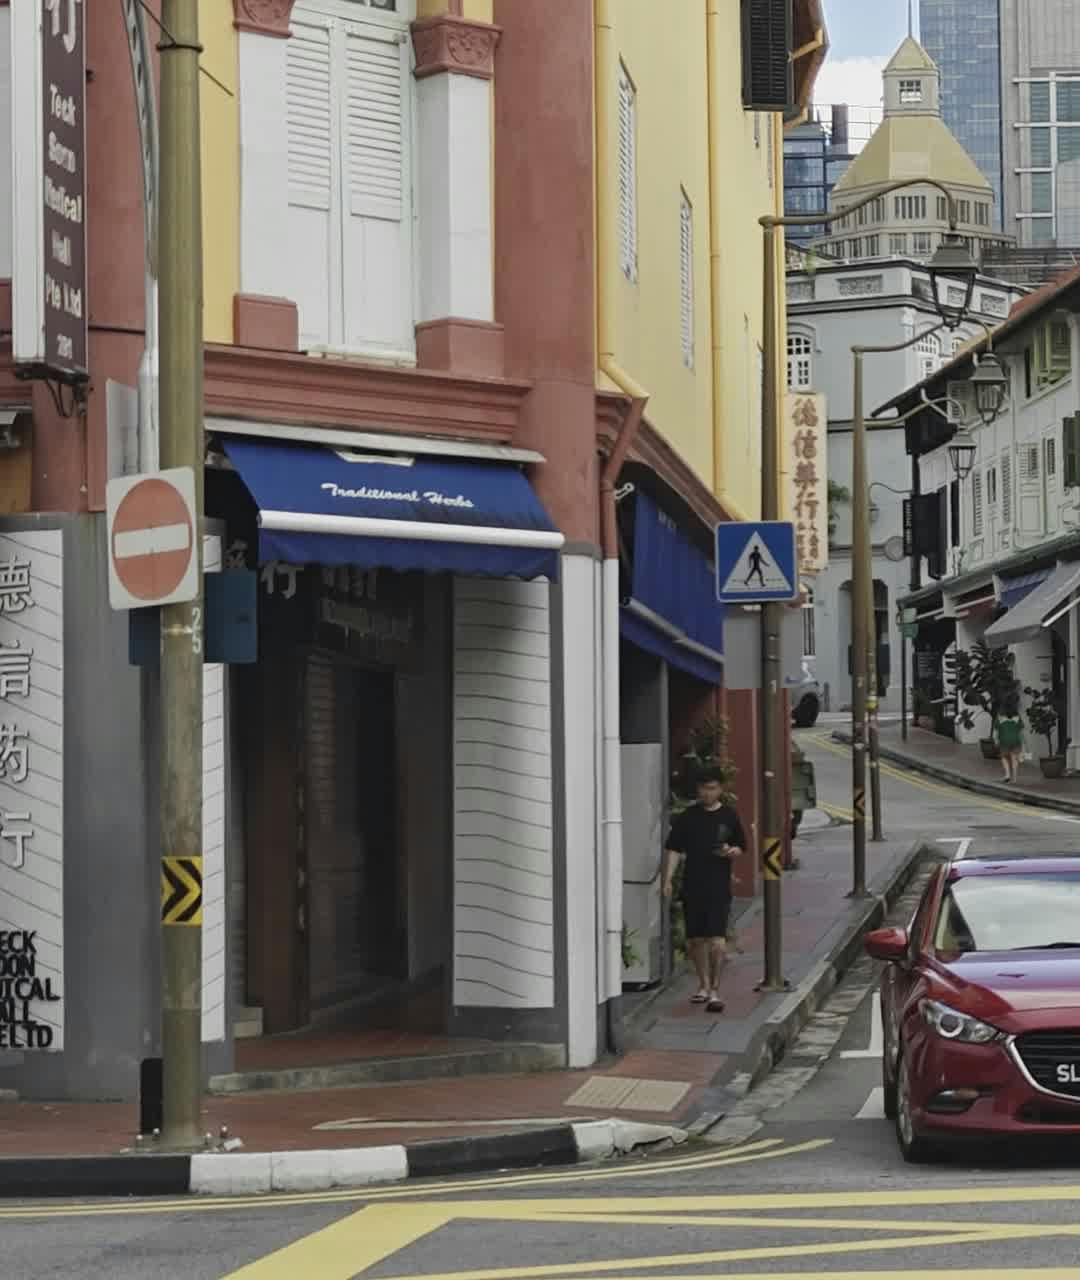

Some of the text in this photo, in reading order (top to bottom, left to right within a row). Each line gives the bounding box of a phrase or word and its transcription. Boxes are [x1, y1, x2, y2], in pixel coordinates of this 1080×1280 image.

[50, 84, 76, 126] Teck
[320, 482, 475, 509] Traditional Herbs
[0, 977, 61, 1001] ICAL
